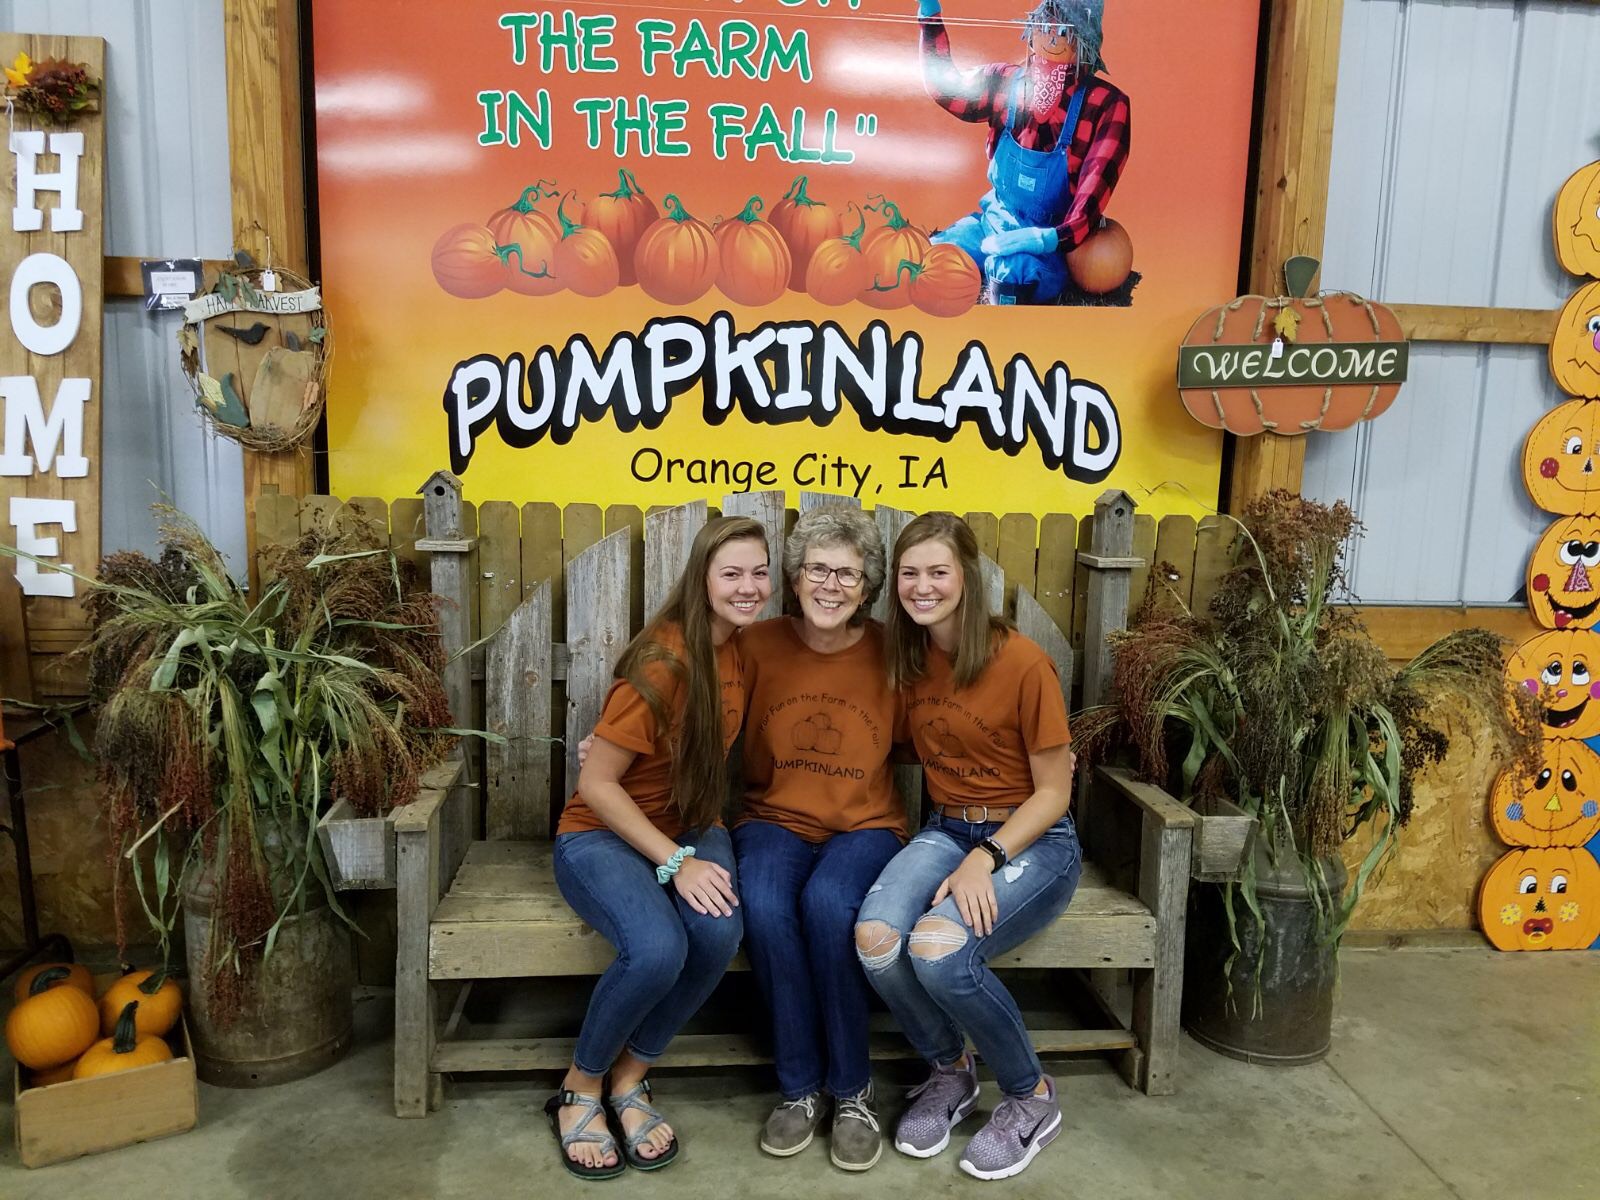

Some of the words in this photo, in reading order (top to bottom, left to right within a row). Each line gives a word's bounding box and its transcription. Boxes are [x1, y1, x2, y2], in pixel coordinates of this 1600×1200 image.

[499, 11, 619, 74] THE
[636, 18, 813, 83] FARM
[477, 89, 552, 150] IN
[573, 94, 690, 158] THE
[0, 130, 92, 598] HOME
[1193, 347, 1398, 381] WELCOME
[443, 310, 1122, 481] PUMPKINLAND
[630, 447, 778, 494] Orange
[793, 452, 882, 498] City,
[898, 455, 948, 489] IA
[769, 702, 785, 716] Fun
[787, 696, 798, 706] on
[801, 692, 817, 702] the
[821, 692, 847, 706] Farm
[860, 709, 873, 726] the
[928, 696, 940, 705] the
[942, 696, 962, 713] Farm
[973, 716, 989, 733] the
[771, 757, 864, 780] UMPKINLAND
